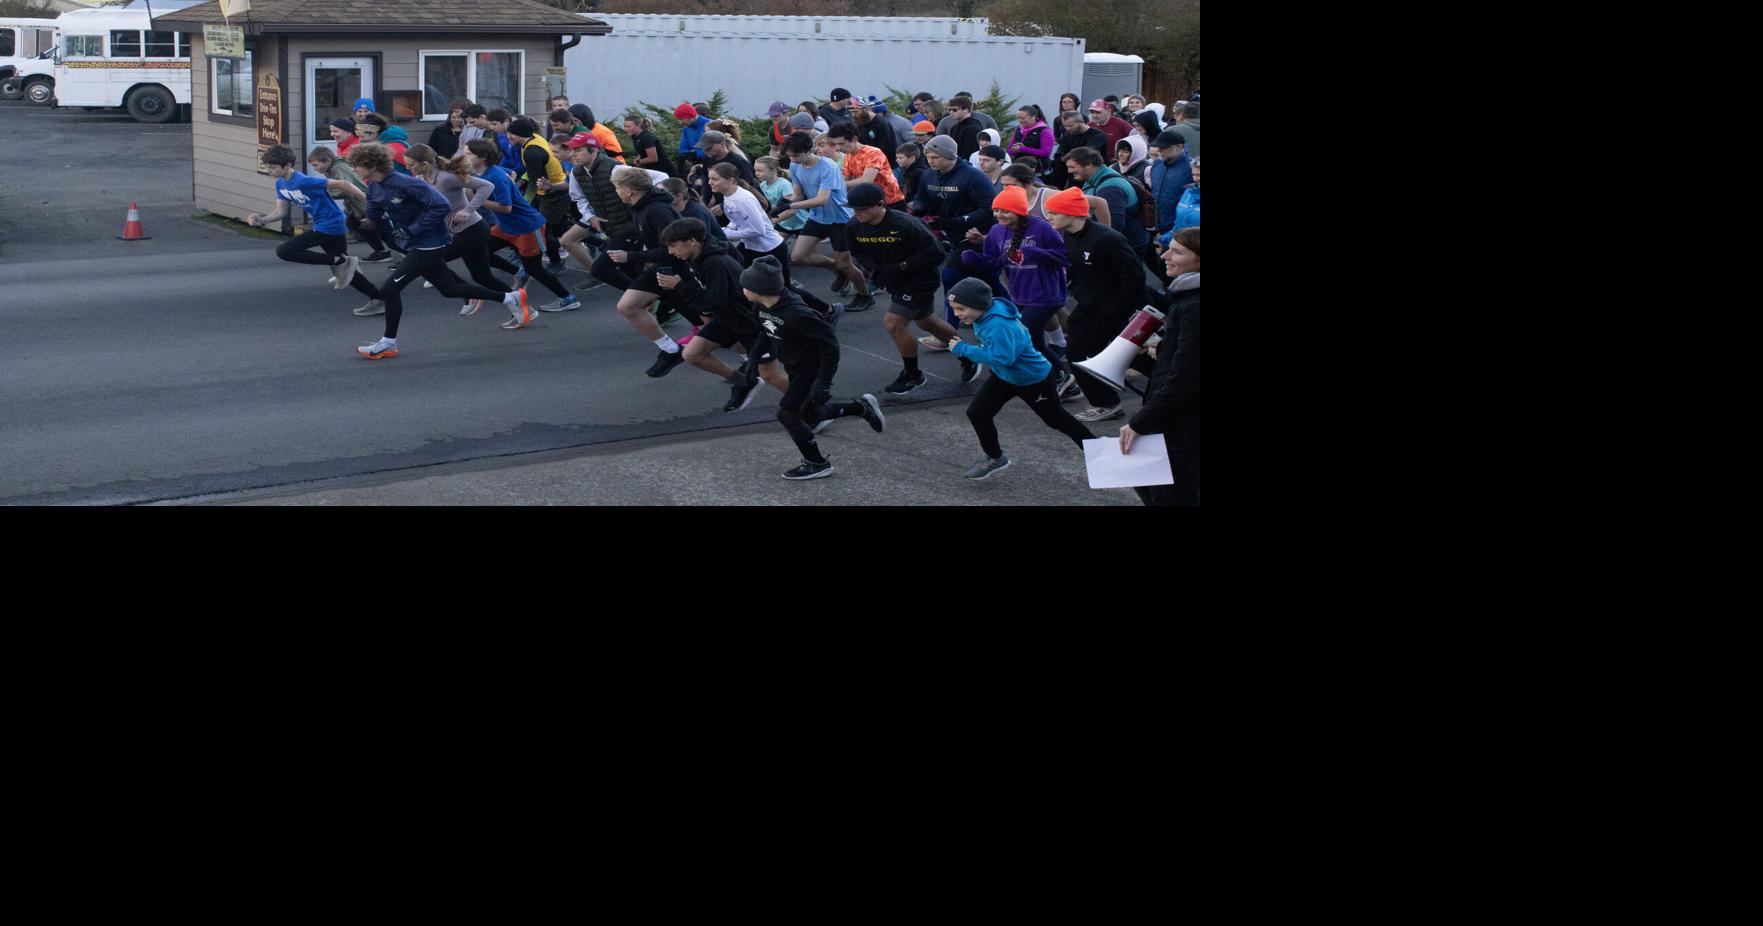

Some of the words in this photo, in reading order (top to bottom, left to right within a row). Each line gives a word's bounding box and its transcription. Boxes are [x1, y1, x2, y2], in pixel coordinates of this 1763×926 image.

[259, 89, 277, 101] Entrance
[262, 115, 275, 129] Stop
[262, 127, 276, 140] Here
